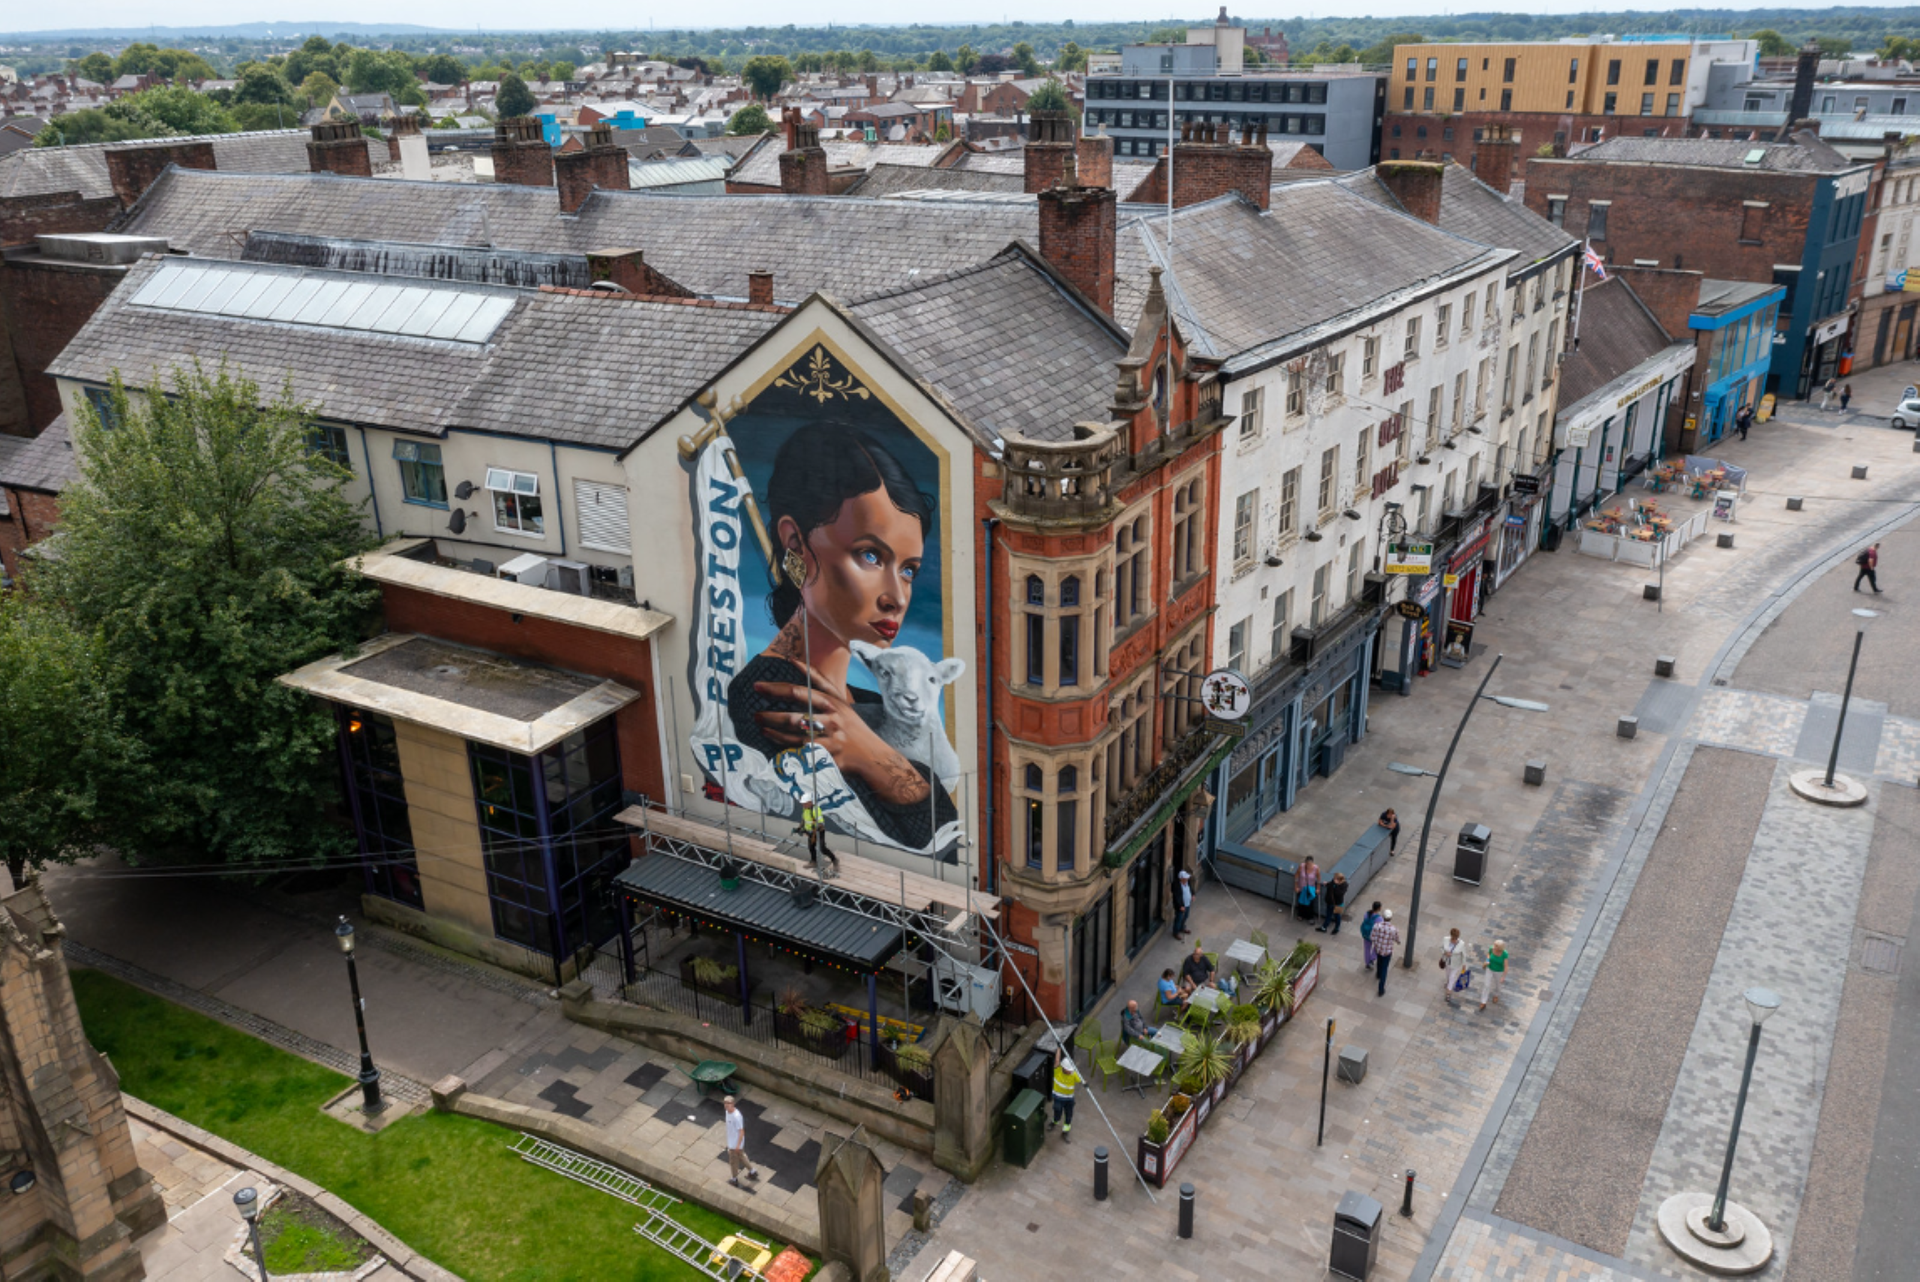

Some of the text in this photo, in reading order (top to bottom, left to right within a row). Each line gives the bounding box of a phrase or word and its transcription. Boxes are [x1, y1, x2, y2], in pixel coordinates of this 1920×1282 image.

[1384, 361, 1405, 396] THE
[1371, 460, 1399, 499] BULL
[708, 479, 740, 706] PRESTON
